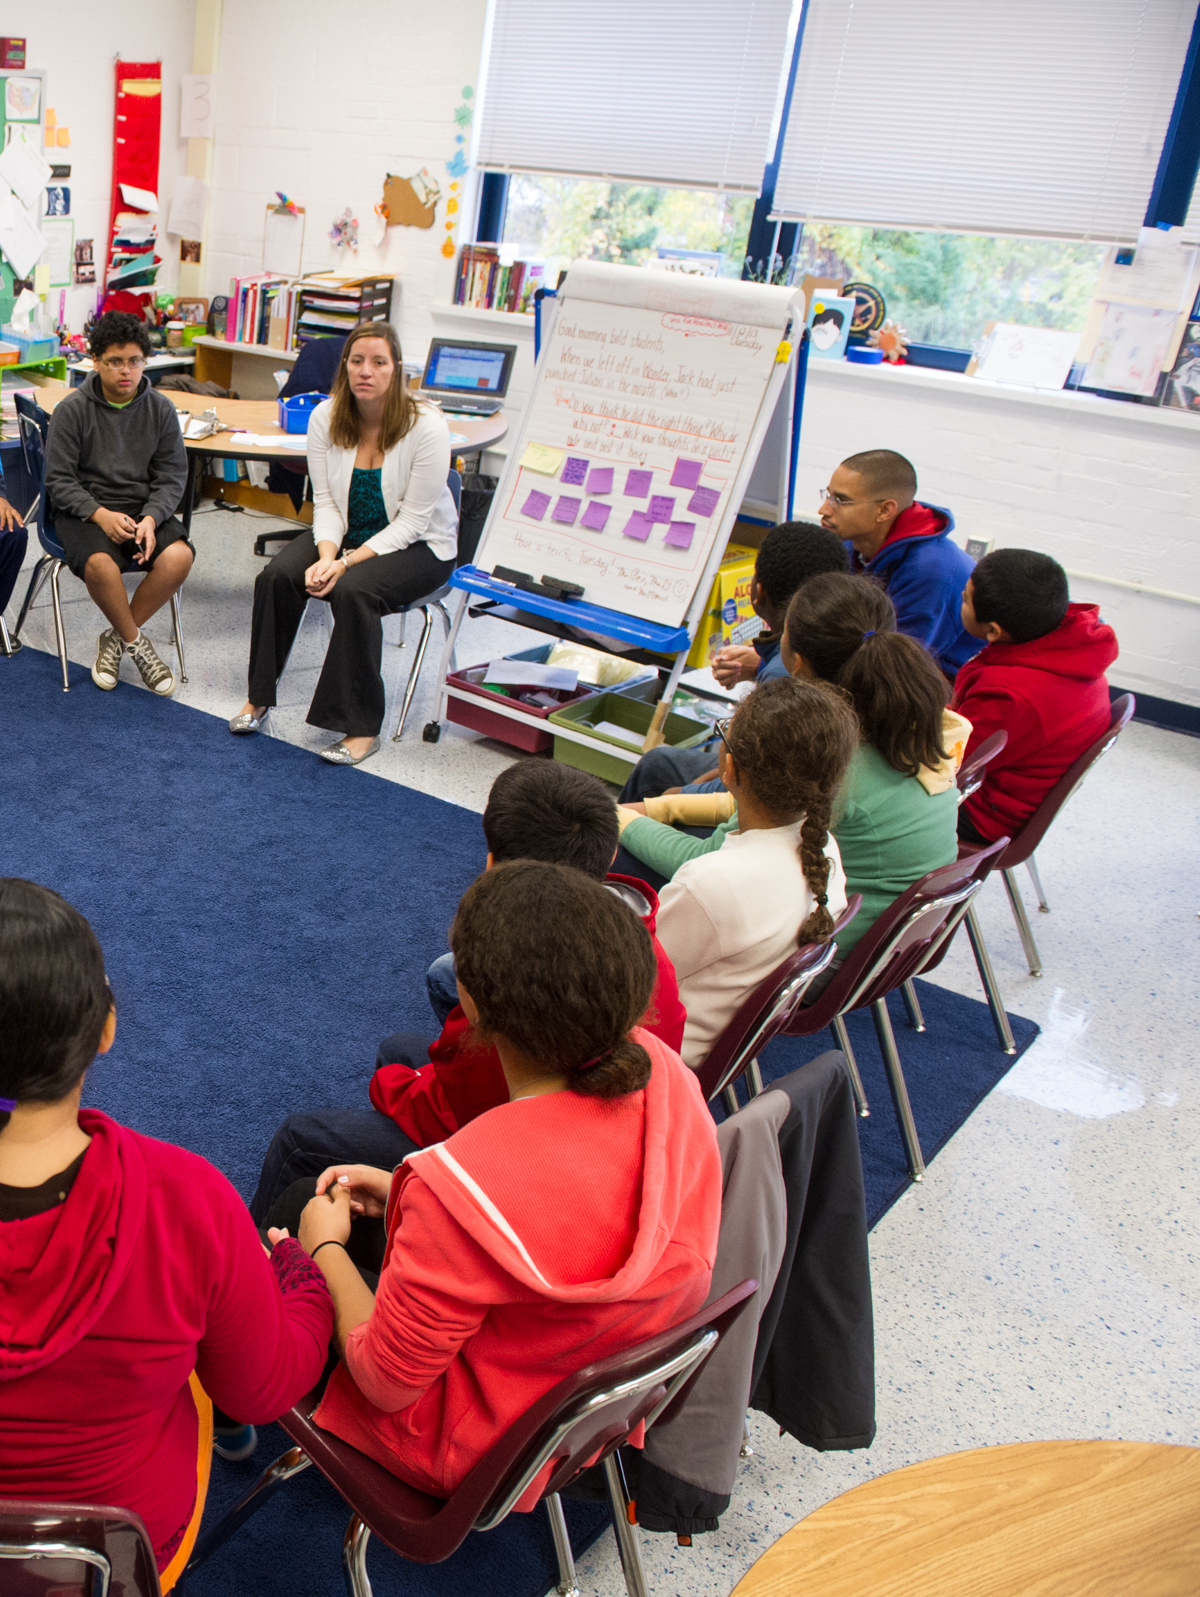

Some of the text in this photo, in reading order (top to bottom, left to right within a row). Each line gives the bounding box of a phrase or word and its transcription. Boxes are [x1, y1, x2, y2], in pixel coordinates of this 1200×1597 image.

[194, 81, 211, 121] 3
[557, 318, 664, 354] Good morning bold students,
[729, 336, 763, 357] Tuesday
[544, 367, 657, 399] punched Julian in the mouth
[560, 346, 581, 366] When
[583, 357, 594, 369] we
[596, 353, 615, 371] left
[615, 356, 633, 376] off
[632, 364, 640, 377] in
[672, 365, 698, 387] Jack
[697, 371, 714, 391] had
[711, 373, 736, 398] just
[568, 393, 579, 410] Do
[581, 401, 594, 417] you
[631, 405, 644, 422] did
[646, 409, 660, 426] the
[659, 412, 681, 434] right
[572, 417, 588, 435] why
[640, 431, 655, 447] your
[657, 428, 689, 455] thoughts
[690, 446, 699, 456] on
[583, 435, 597, 450] and
[599, 440, 613, 456] post
[614, 441, 623, 456] it
[513, 530, 533, 551] Have
[535, 543, 543, 551] a
